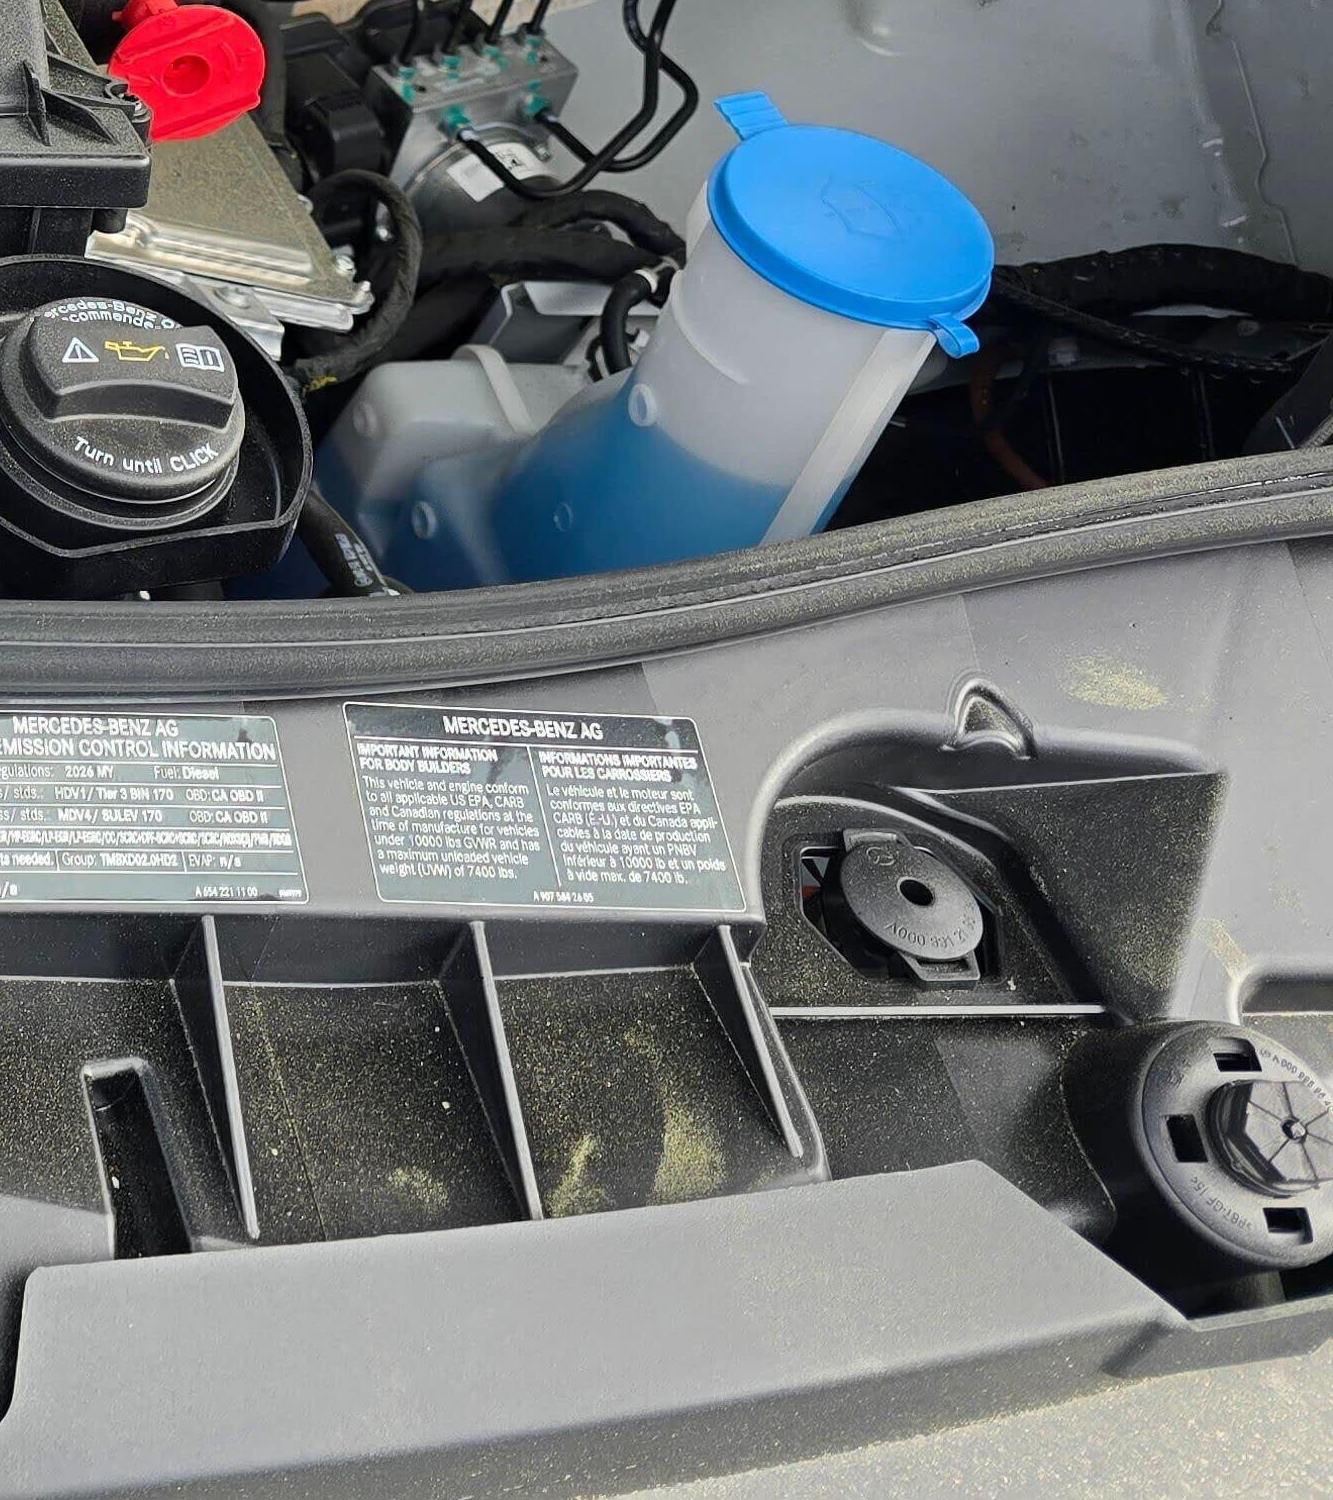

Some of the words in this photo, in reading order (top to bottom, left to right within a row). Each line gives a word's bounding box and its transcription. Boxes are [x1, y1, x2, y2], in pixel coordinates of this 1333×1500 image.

[44, 300, 157, 322] ercedes-Benz
[74, 436, 114, 466] Turn
[122, 457, 163, 473] until
[170, 442, 219, 472] CLICK
[13, 716, 151, 736] MERCEDES-BENZ
[155, 719, 179, 737] AG
[442, 716, 577, 738] MERCEDES-BENZ
[580, 723, 603, 740] AG
[79, 738, 159, 758] CONTROL
[162, 741, 276, 760] INFORMATION
[357, 743, 419, 759] IMPORTANT
[422, 746, 498, 762] INFORMATION
[360, 757, 383, 770] FOR
[385, 759, 415, 772] BODY
[417, 760, 471, 774] BUILDERS
[539, 751, 620, 767] INFORMATIONS
[622, 755, 697, 770] IMPORTANTES
[65, 765, 94, 778] 2026
[97, 766, 114, 778] MY
[153, 766, 181, 780] Fuel:
[183, 766, 219, 780] Diesel
[542, 765, 574, 779] POUR
[576, 766, 595, 779] LES
[597, 768, 672, 782] CARROSSIERS
[55, 787, 94, 800] HDV1/
[96, 787, 117, 800] Tier
[119, 788, 128, 800] 3
[130, 788, 150, 800] BIN
[153, 788, 174, 800] 170
[362, 775, 385, 789] This
[388, 776, 424, 791] vehicle
[427, 779, 447, 792] and
[449, 781, 483, 797] engine
[486, 781, 529, 795] conform
[546, 784, 559, 796] Le
[562, 784, 604, 798] véhicule
[606, 786, 618, 798] et
[621, 786, 629, 798] le
[632, 788, 669, 800] moteur
[672, 789, 694, 800] sont
[186, 789, 211, 801] OBD:
[212, 789, 228, 801] CA
[230, 790, 253, 802] OBD
[256, 790, 264, 802] II
[365, 790, 378, 802] to
[380, 790, 392, 803] all
[395, 791, 448, 807] applicable
[450, 794, 466, 807] US
[469, 795, 493, 809] EPA,
[495, 796, 524, 808] CARB
[369, 805, 389, 817] and
[391, 806, 440, 819] Canadian
[443, 808, 501, 823] regulations
[503, 811, 515, 822] at
[516, 810, 534, 823] the
[550, 800, 605, 812] conformes
[607, 802, 626, 812] aux
[628, 800, 678, 814] directives
[680, 802, 701, 814] EPA
[57, 809, 98, 824] MDV4/
[102, 810, 138, 822] SULEV
[142, 810, 163, 822] 170
[190, 811, 215, 823] OBD:
[216, 811, 232, 823] CA
[234, 811, 258, 824] OBD
[260, 812, 268, 824] II
[371, 818, 396, 831] time
[398, 820, 410, 832] of
[412, 821, 477, 835] manufacture
[479, 822, 494, 835] for
[497, 824, 540, 837] vehicles
[375, 834, 404, 846] under
[410, 834, 442, 847] 10000
[445, 835, 461, 848] lbs
[463, 836, 497, 850] GVWR
[499, 838, 519, 850] and
[521, 839, 540, 851] has
[13, 853, 54, 866] needed.
[62, 853, 96, 868] Group:
[189, 855, 215, 867] EVAP:
[220, 854, 241, 869] n/a
[378, 850, 385, 859] a
[387, 849, 438, 862] maximum
[442, 851, 490, 864] unloaded
[492, 852, 529, 865] vehicle
[379, 862, 416, 877] weight
[418, 864, 452, 879] (UVW)
[454, 865, 465, 877] of
[467, 865, 496, 878] 7400
[498, 866, 517, 879] lbs.
[567, 868, 574, 881] à
[576, 869, 598, 882] vide
[601, 873, 626, 883] max.
[628, 870, 642, 883] de
[644, 870, 672, 884] 7400
[675, 871, 688, 884] lb.
[195, 886, 202, 896] A
[219, 886, 234, 897] 221
